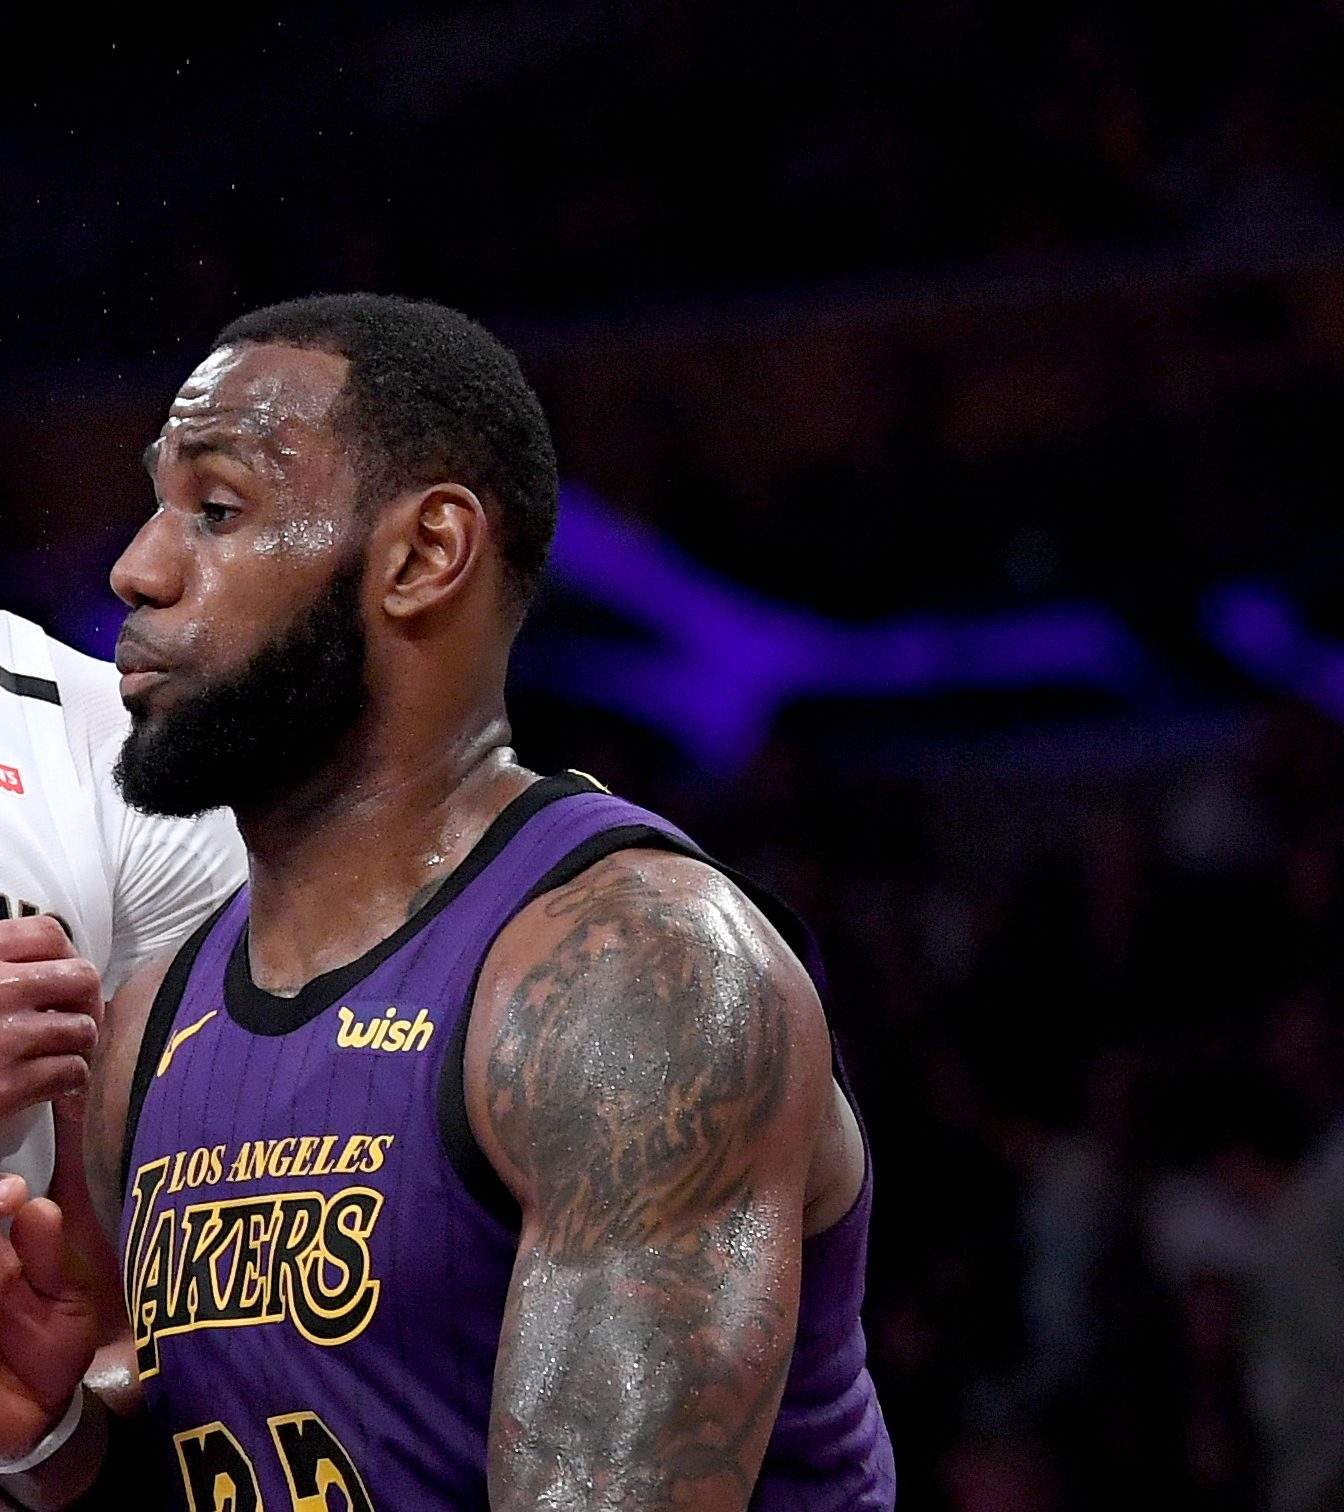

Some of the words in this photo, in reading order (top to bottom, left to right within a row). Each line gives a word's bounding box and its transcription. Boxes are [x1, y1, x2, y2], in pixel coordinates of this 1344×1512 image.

[337, 1006, 434, 1052] wish
[167, 1143, 227, 1194] LOS
[227, 1135, 395, 1182] ANGELES
[124, 1157, 385, 1381] LAKERS
